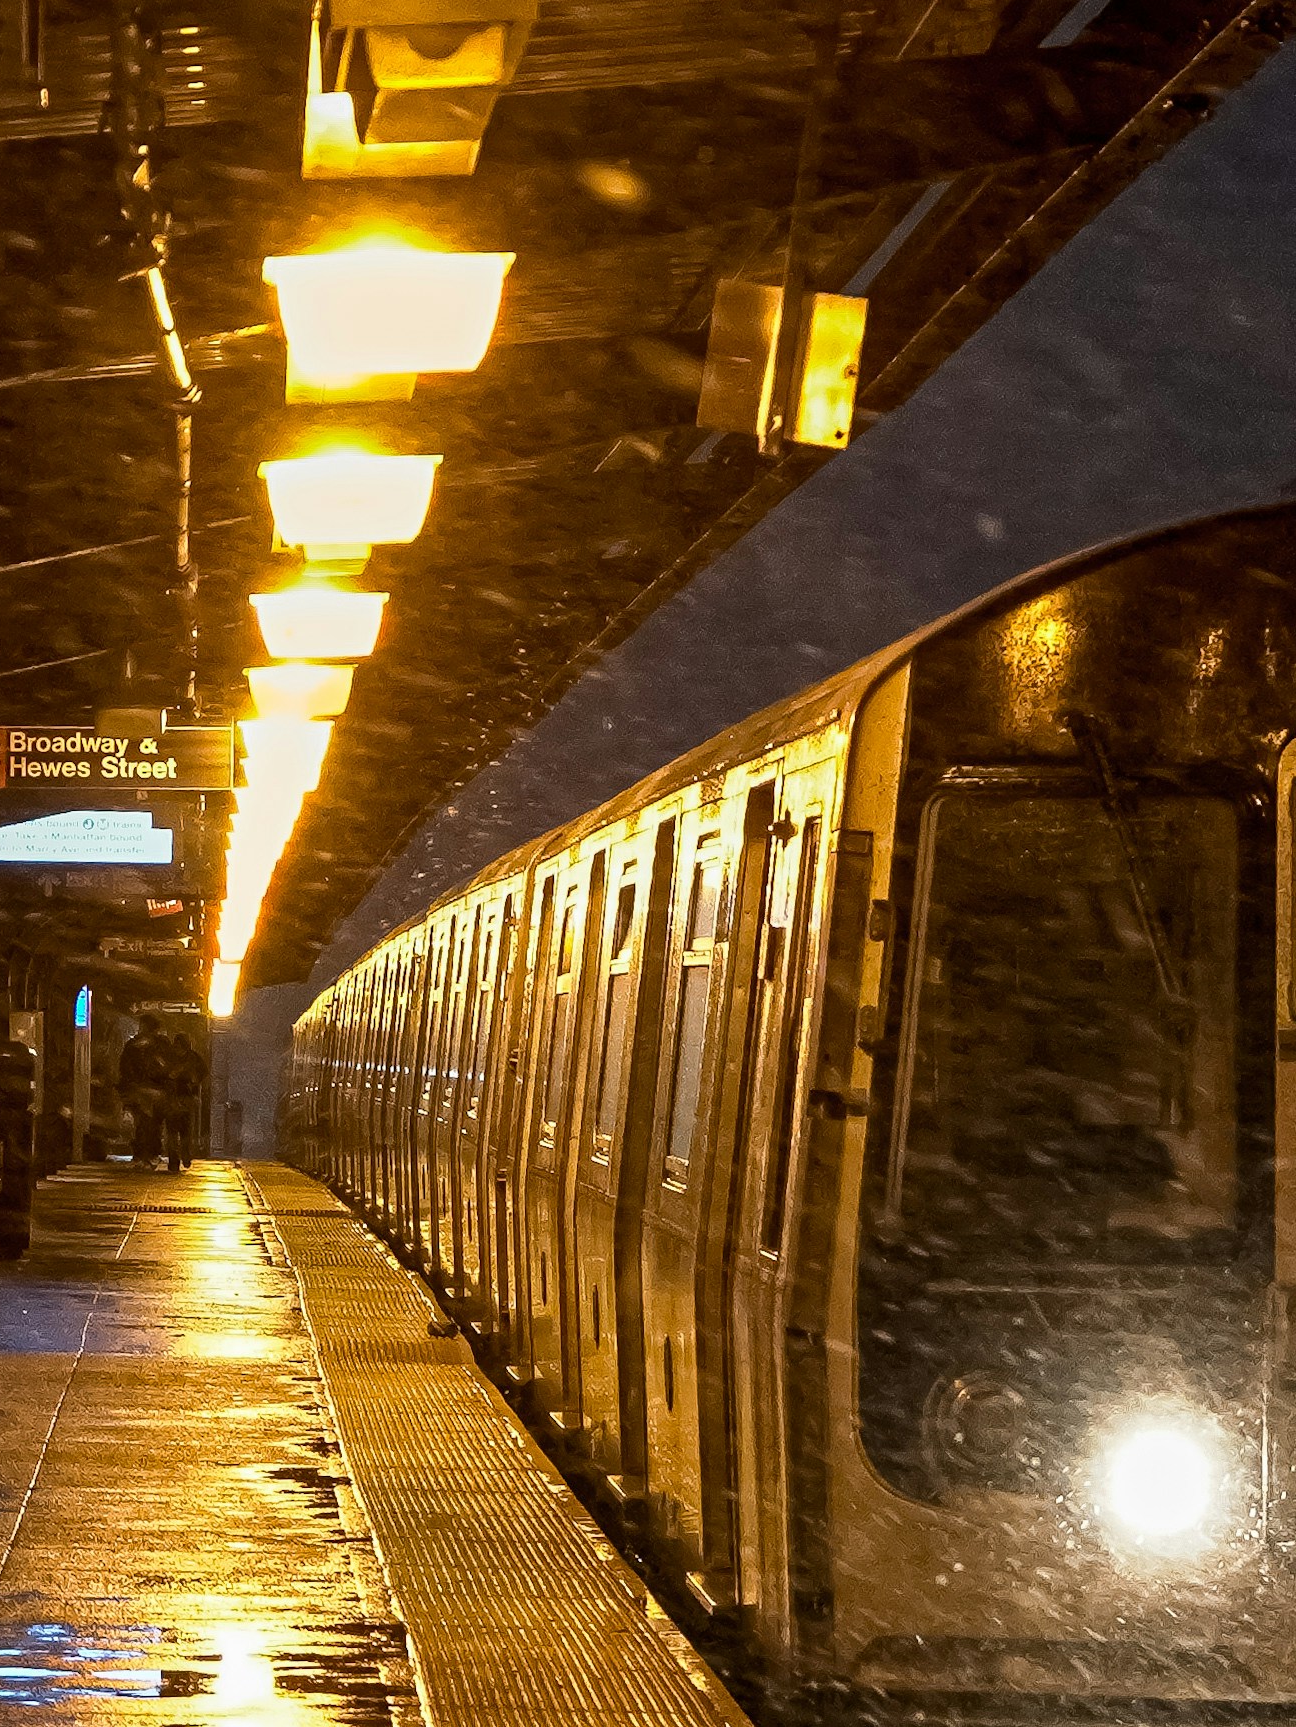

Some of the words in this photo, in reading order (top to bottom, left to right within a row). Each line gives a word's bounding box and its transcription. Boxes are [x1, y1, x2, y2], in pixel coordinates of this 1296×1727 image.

[9, 731, 129, 758] Broadway
[139, 736, 159, 755] &
[9, 756, 91, 778] Hewes
[100, 755, 177, 779] Street
[51, 832, 106, 841] Manhattan
[109, 834, 143, 842] bound
